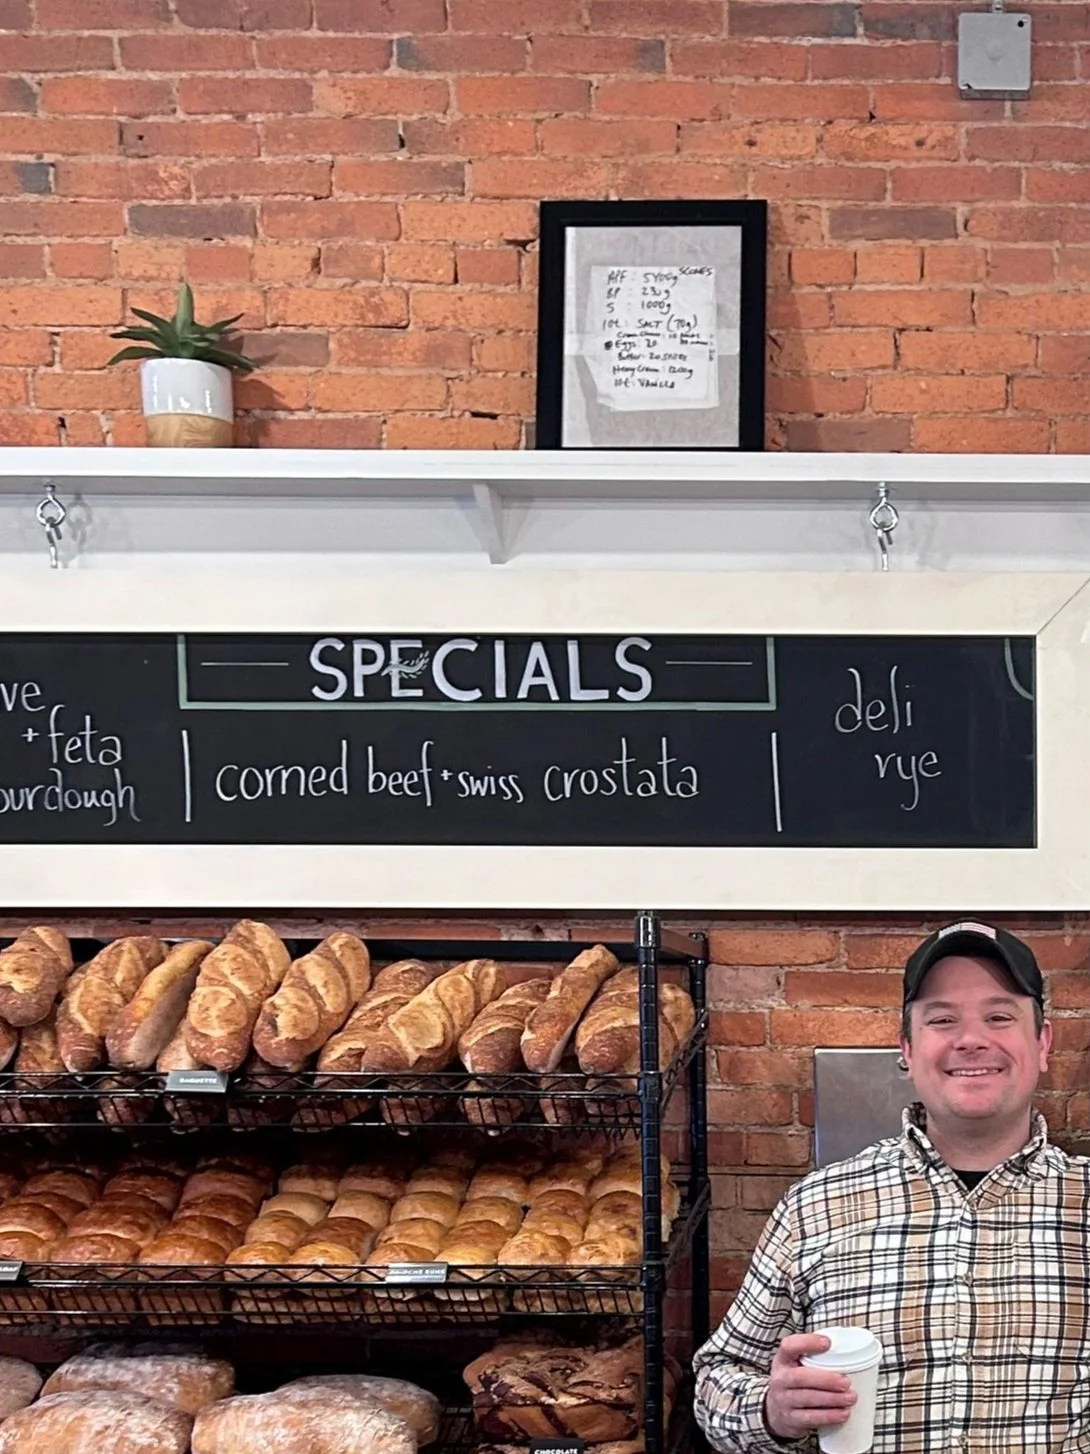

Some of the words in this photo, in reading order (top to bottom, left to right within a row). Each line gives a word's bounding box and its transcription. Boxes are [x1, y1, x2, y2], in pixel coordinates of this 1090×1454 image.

[308, 636, 654, 702] SPECIALS
[834, 665, 917, 734] deli
[48, 704, 122, 766] feta
[215, 739, 349, 802] corned
[543, 736, 700, 803] crostata
[874, 749, 943, 811] rye
